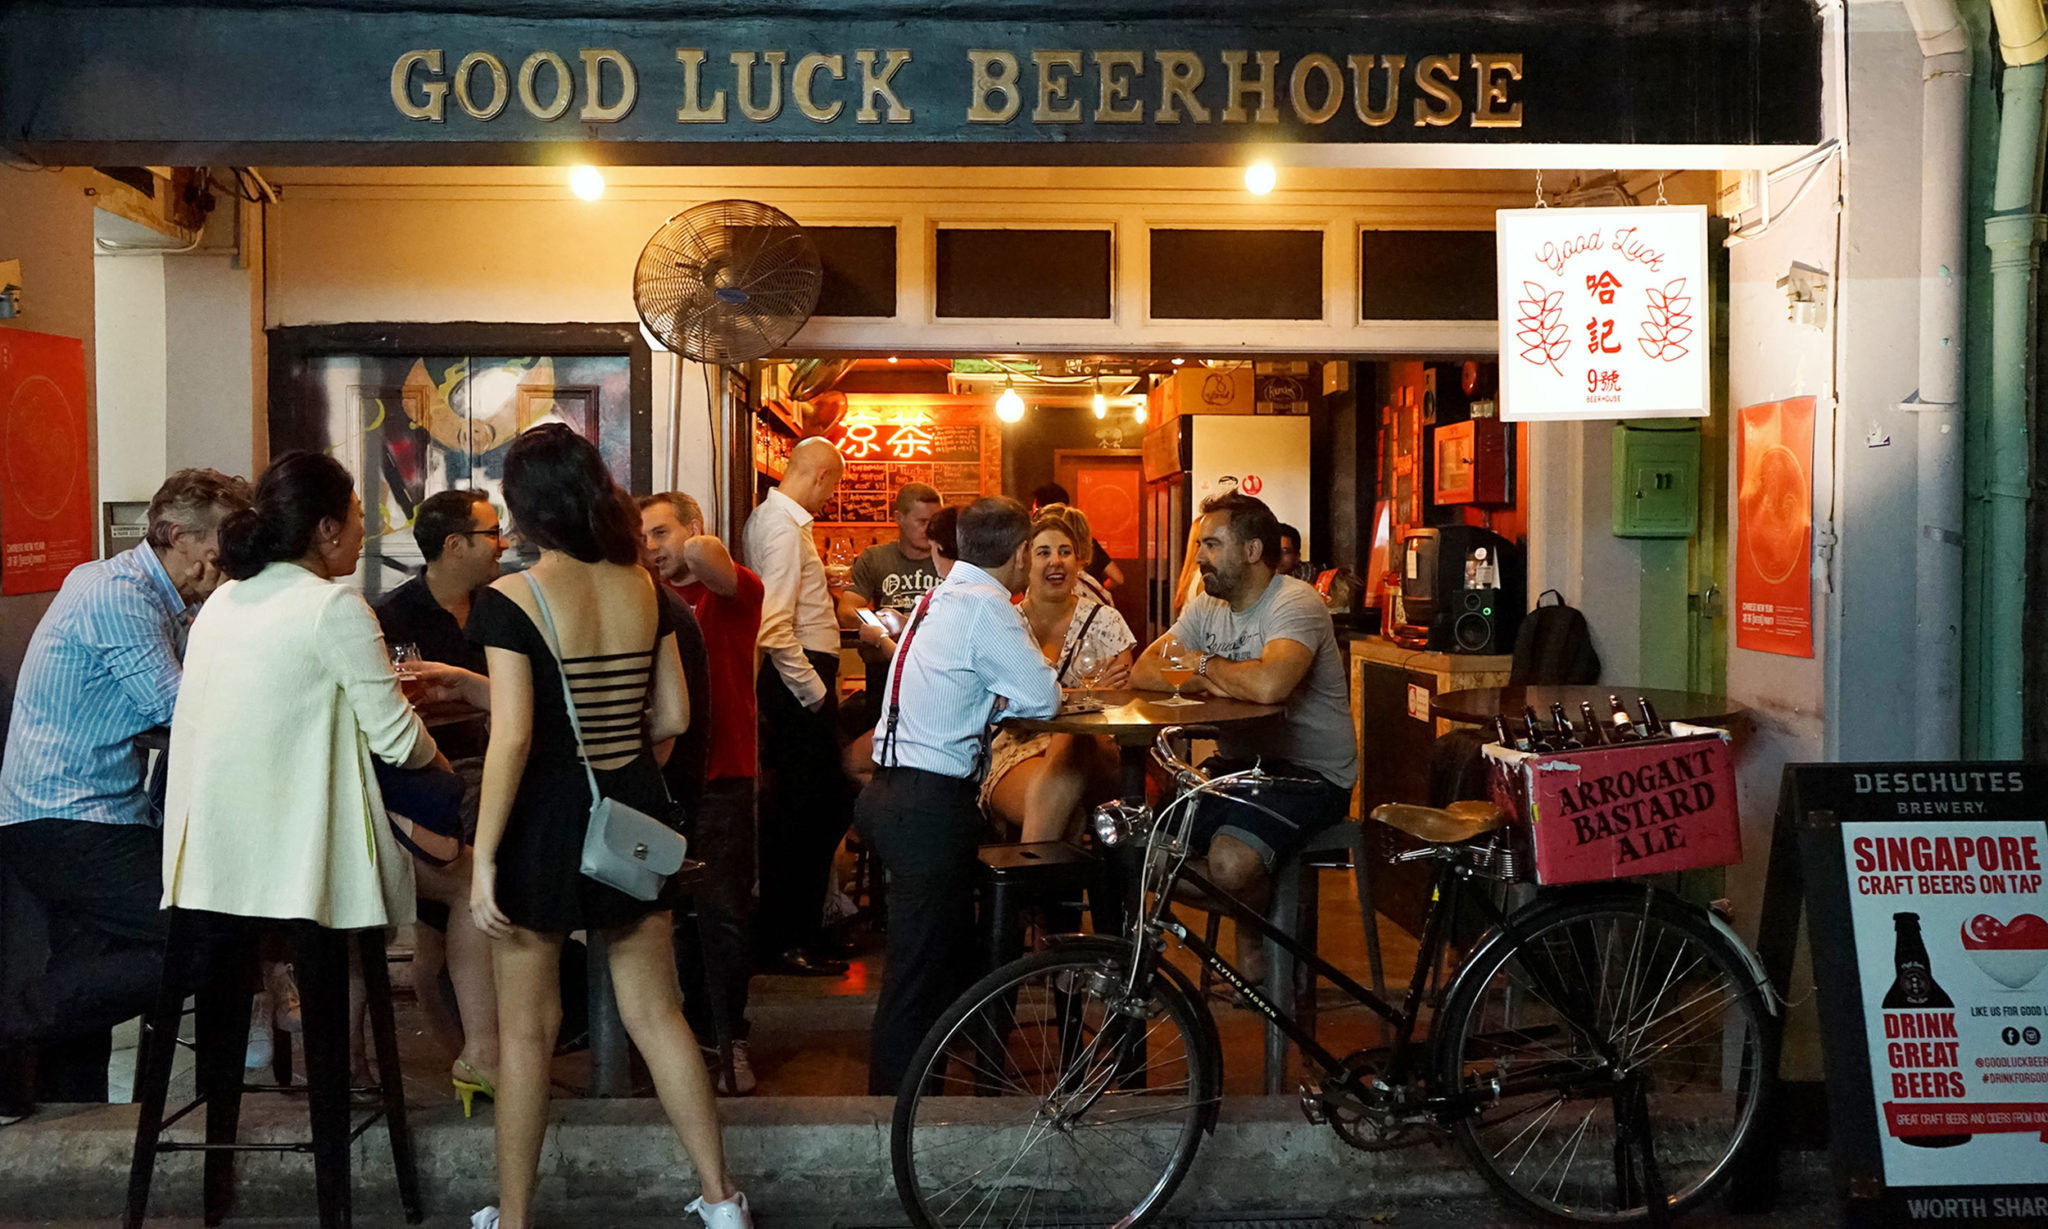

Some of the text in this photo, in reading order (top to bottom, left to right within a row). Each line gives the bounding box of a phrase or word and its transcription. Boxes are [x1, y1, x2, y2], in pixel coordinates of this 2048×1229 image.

[390, 48, 1524, 129] GOOD LUCK BEERHOUSE
[1535, 227, 1665, 277] Good Luck
[1586, 395, 1621, 403] BEERHOUSE
[882, 568, 945, 596] Oxfor
[1560, 749, 1714, 816] ARROGANT
[1854, 772, 2024, 793] DESCHUTES
[1571, 781, 1716, 846] BASTARD
[1616, 823, 1686, 865] ALE
[1853, 836, 2042, 872] SINGAPORE
[1858, 874, 2042, 895] CRAFT BEERS ON TAP
[1210, 957, 1277, 1019] FLYING PIGEON
[1971, 1006, 1988, 1017] LIKE
[1990, 1006, 2001, 1016] US
[2003, 1006, 2019, 1016] FOR
[2020, 1005, 2042, 1016] GOOD
[1883, 1013, 1958, 1039] DRINK
[1888, 1042, 1960, 1069] GREAT
[1891, 1071, 1966, 1099] BEERS
[1982, 1072, 2048, 1084] #DRINKFORGOO
[1897, 1114, 1920, 1125] GREAT
[1921, 1114, 1944, 1125] CRAFT
[1946, 1113, 1969, 1125] BEERS
[1971, 1113, 1985, 1124] AND
[1987, 1113, 2011, 1124] CIDERS
[2013, 1112, 2032, 1123] FROM
[1908, 1199, 1987, 1219] WORTH
